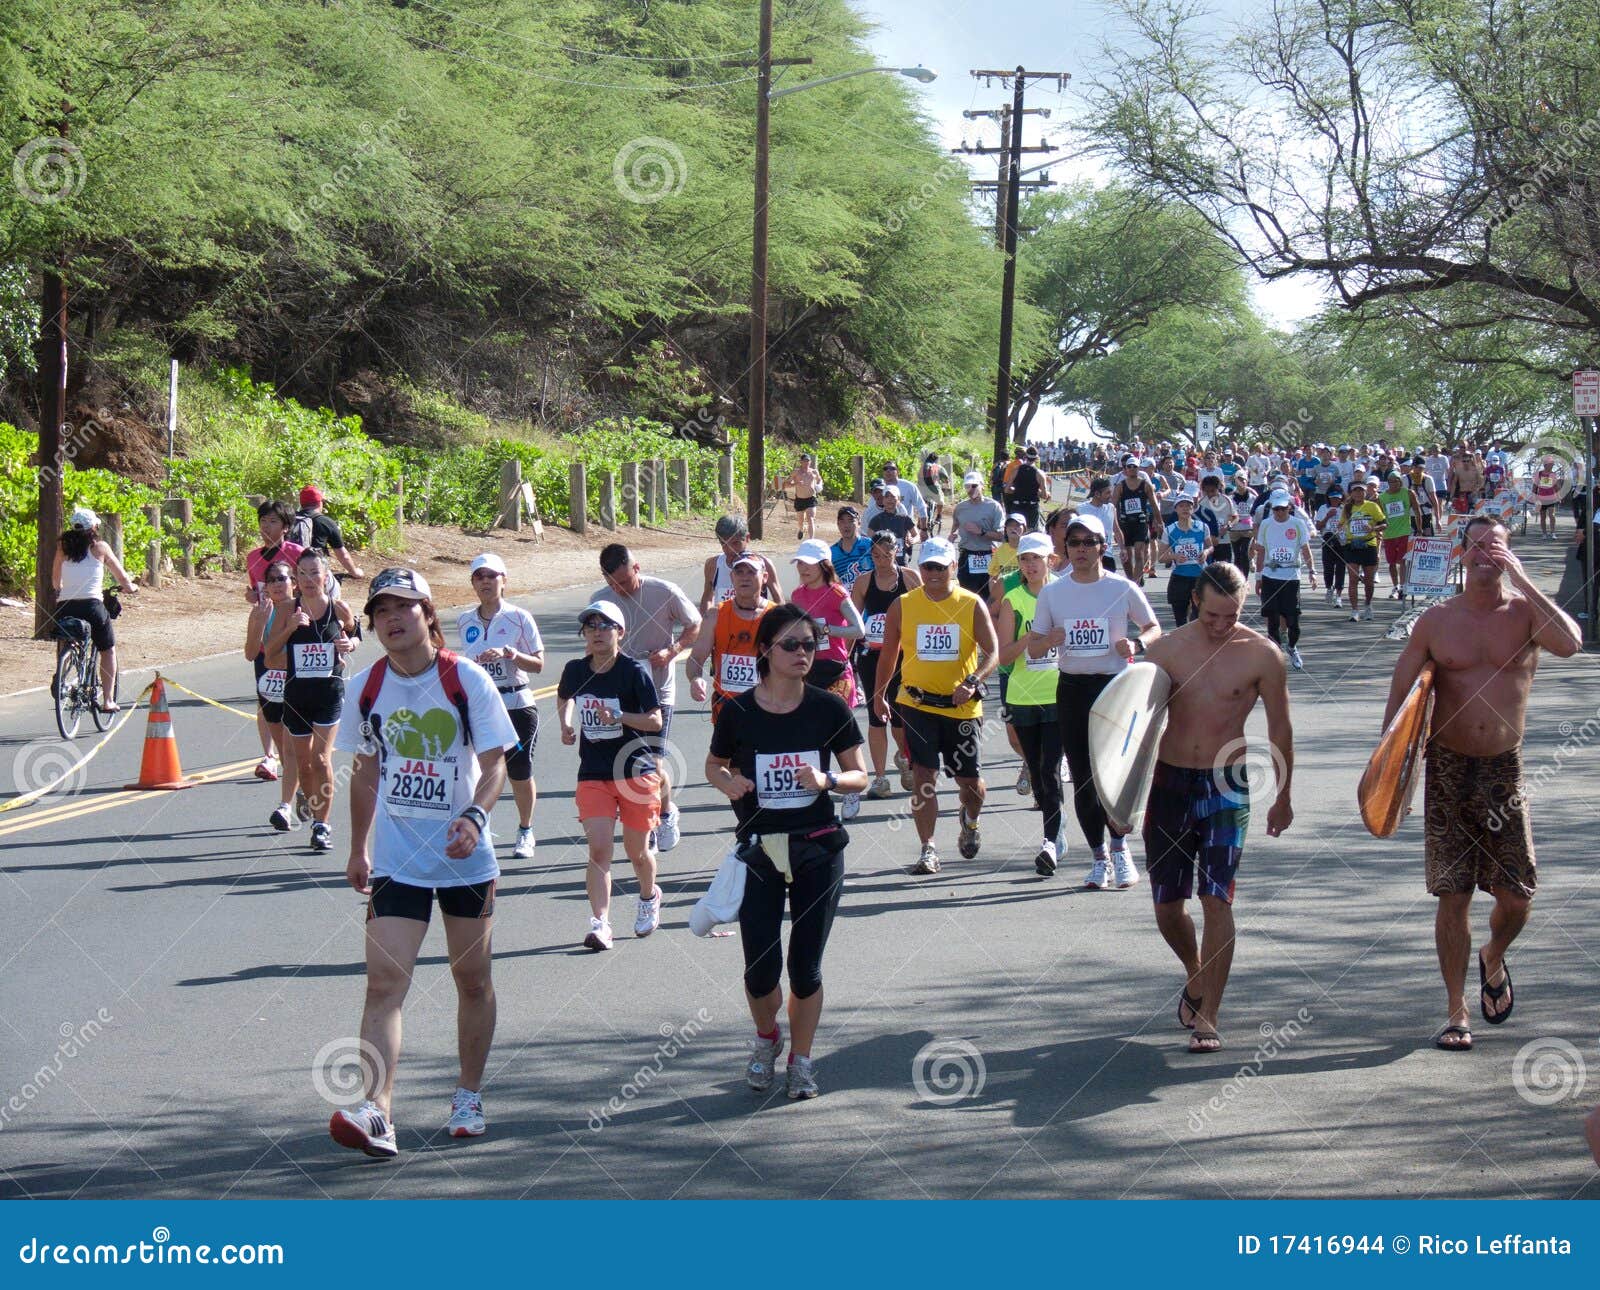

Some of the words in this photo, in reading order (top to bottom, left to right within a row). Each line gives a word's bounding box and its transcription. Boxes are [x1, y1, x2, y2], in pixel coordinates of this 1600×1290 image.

[1415, 541, 1427, 551] NO
[926, 626, 950, 634] JAL
[1073, 620, 1098, 629] JAL
[925, 635, 951, 649] 3150
[1069, 629, 1104, 645] 16907
[302, 644, 326, 653] JAL
[302, 653, 328, 666] 2753
[728, 657, 753, 666] JAL
[481, 663, 502, 676] 796
[727, 666, 753, 681] 6352
[265, 680, 285, 692] 723
[400, 760, 440, 777] JAL
[769, 755, 807, 769] JAL
[764, 769, 803, 791] 1592
[391, 773, 446, 802] 28204
